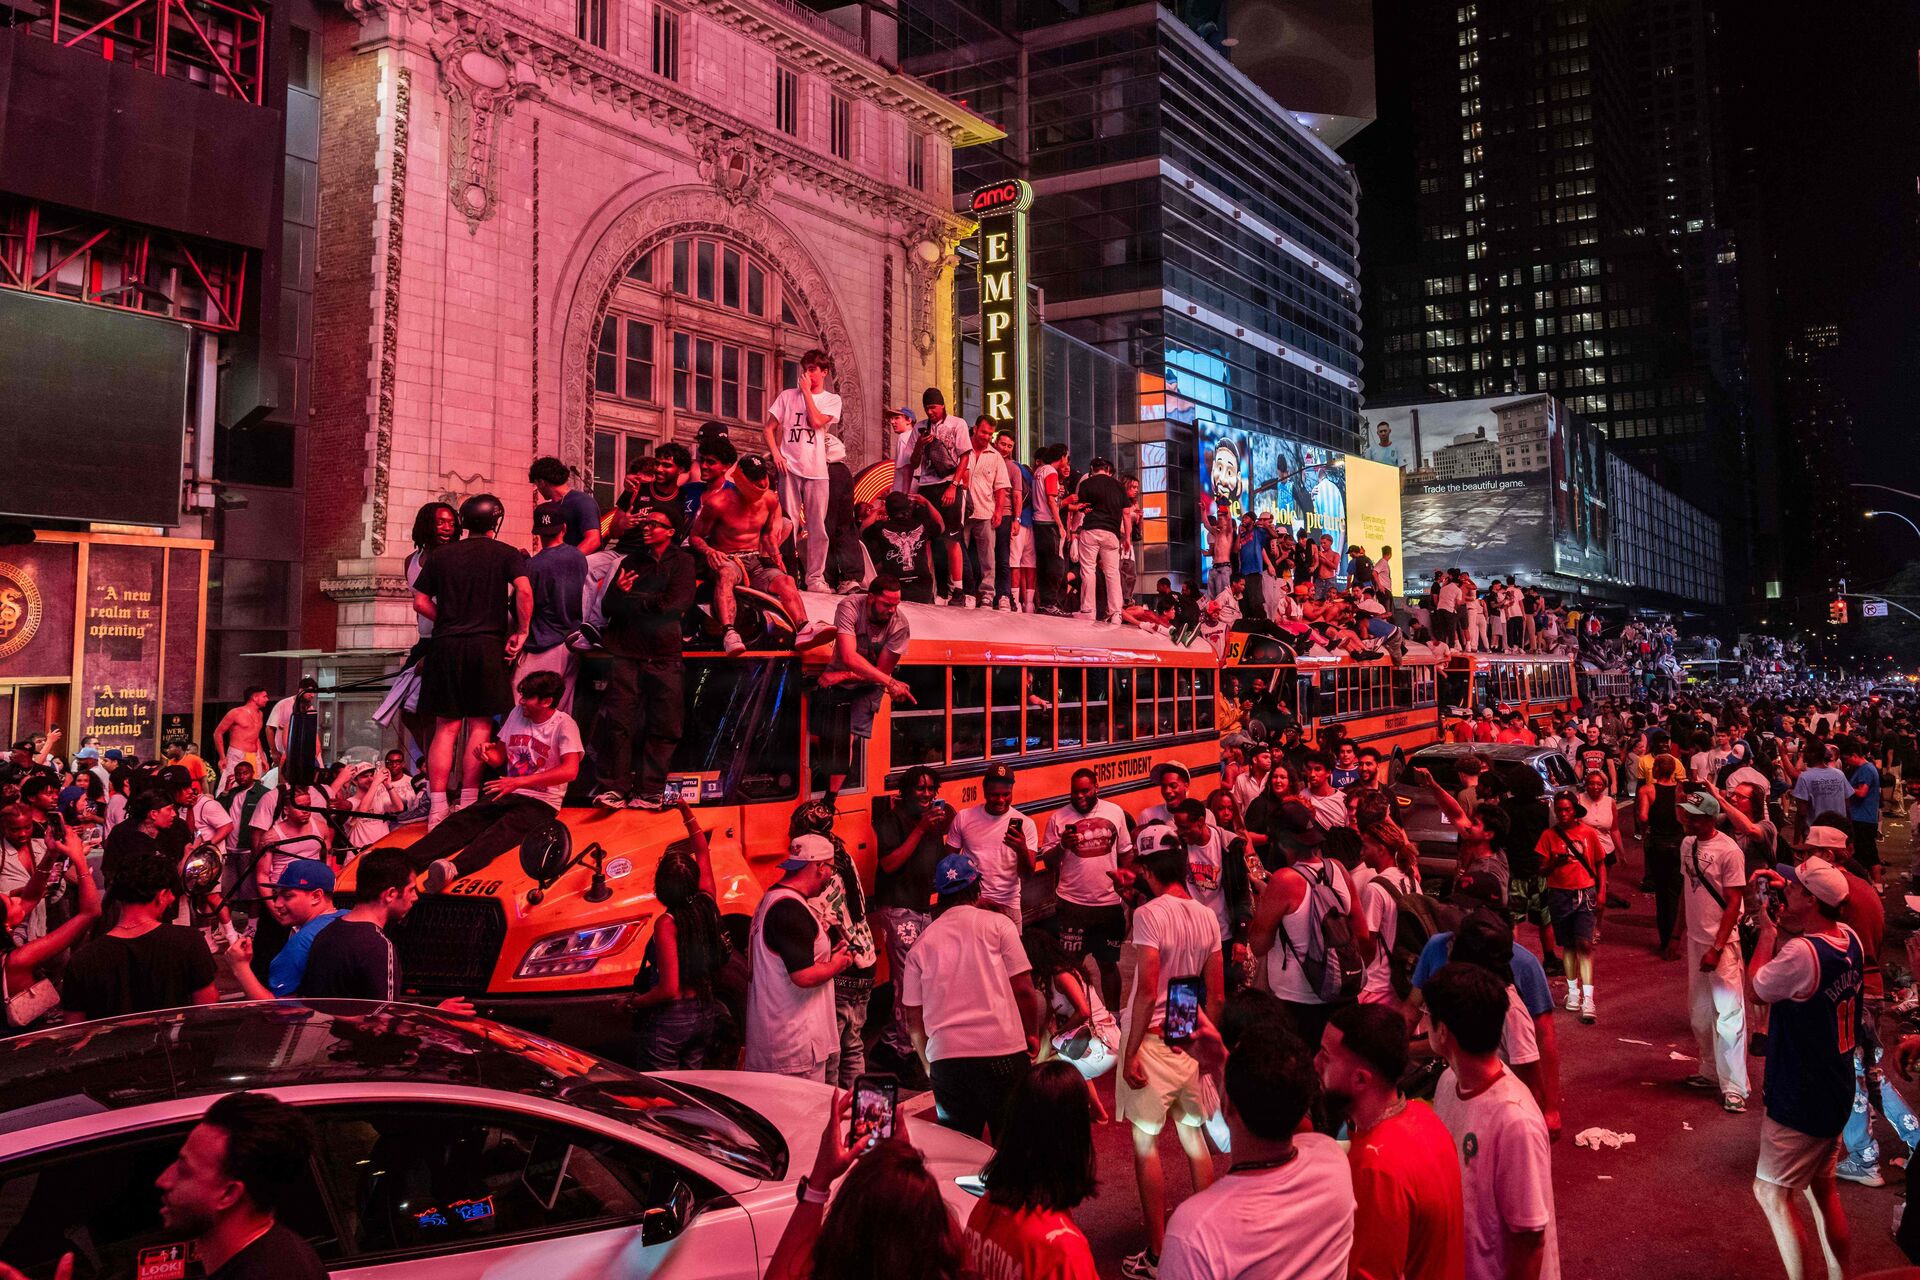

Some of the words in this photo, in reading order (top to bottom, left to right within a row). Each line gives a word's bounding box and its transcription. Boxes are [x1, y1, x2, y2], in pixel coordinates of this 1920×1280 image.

[974, 184, 1016, 209] amc
[982, 232, 1014, 440] EMPIR
[793, 412, 804, 427] I
[787, 427, 816, 445] NY
[1423, 485, 1446, 494] Trade
[1447, 483, 1461, 492] the
[1462, 480, 1498, 491] beautiful
[1499, 480, 1526, 490] game.
[1306, 511, 1345, 533] picture
[123, 591, 151, 601] new
[90, 605, 131, 619] realm
[136, 606, 150, 619] is
[1226, 642, 1239, 658] US
[119, 688, 148, 699] new
[86, 704, 128, 717] realm
[133, 704, 147, 717] is
[1093, 762, 1117, 782] FIRST
[1117, 756, 1152, 779] STUDENT
[962, 785, 977, 803] 2916
[450, 878, 503, 896] 2916
[1836, 996, 1856, 1054] 11
[141, 1261, 182, 1277] LOOK!
